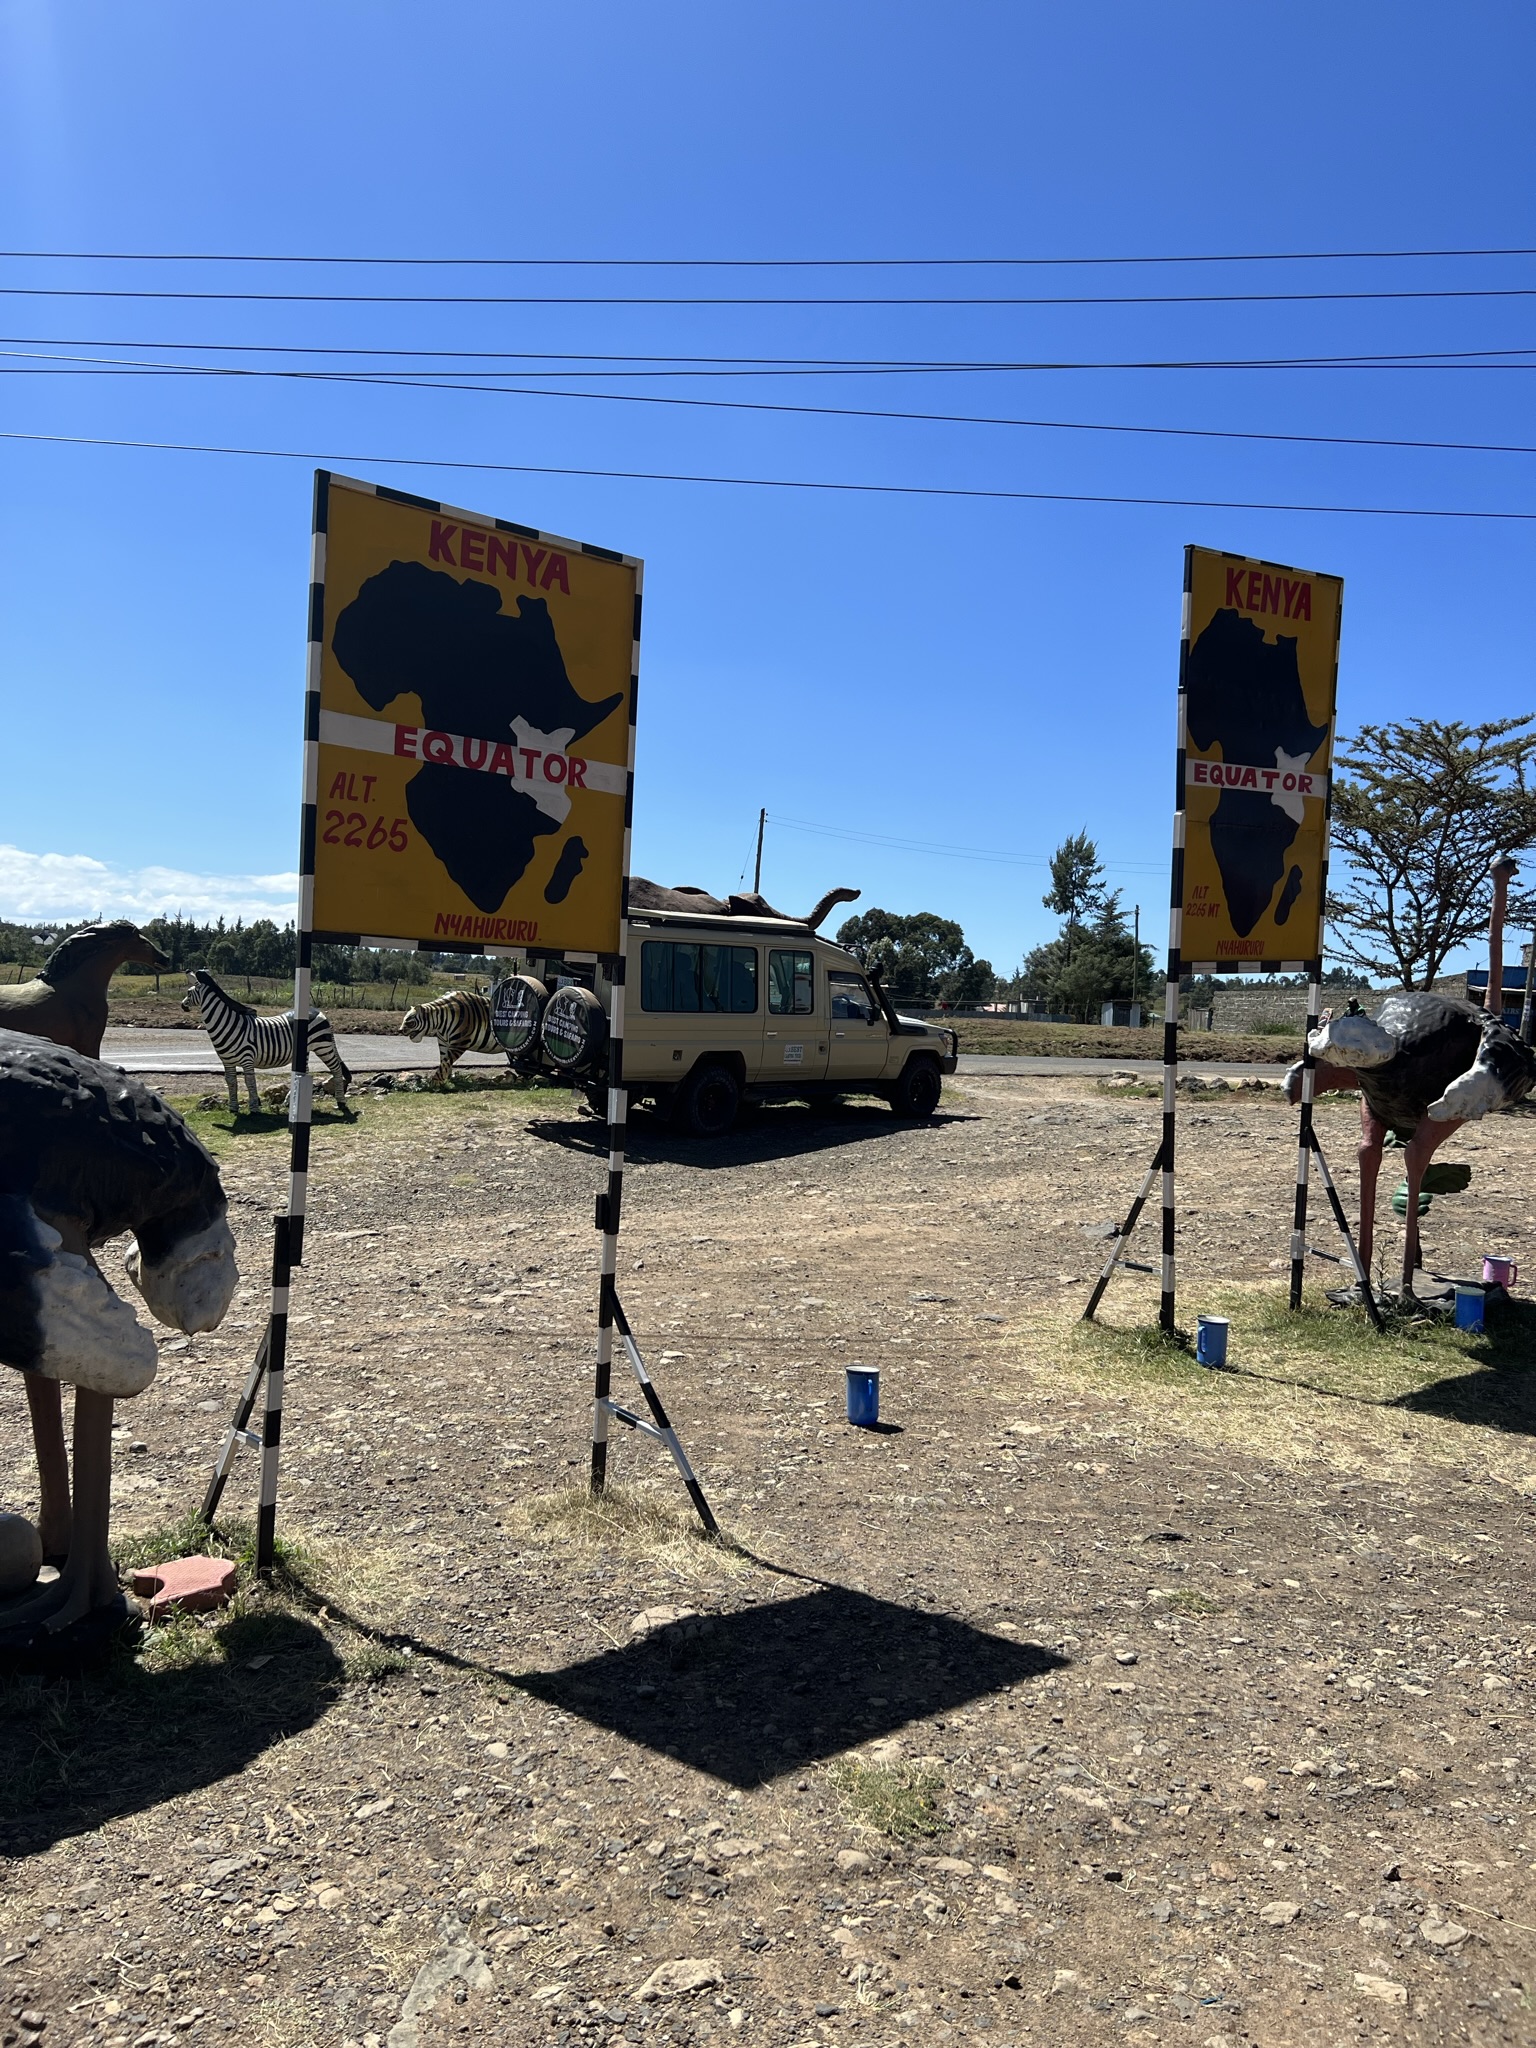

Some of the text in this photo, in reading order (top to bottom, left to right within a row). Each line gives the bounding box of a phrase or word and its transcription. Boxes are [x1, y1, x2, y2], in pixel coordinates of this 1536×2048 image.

[428, 520, 571, 596] KENYA
[1225, 567, 1312, 621] KENYA
[394, 723, 588, 789] EQUATOR
[329, 771, 377, 804] ALT.
[1193, 763, 1313, 794] EQUATOR
[322, 809, 409, 853] 2265
[1191, 885, 1210, 900] ALT
[1185, 902, 1220, 918] 2265 MT
[1215, 940, 1265, 956] NYAHURURU
